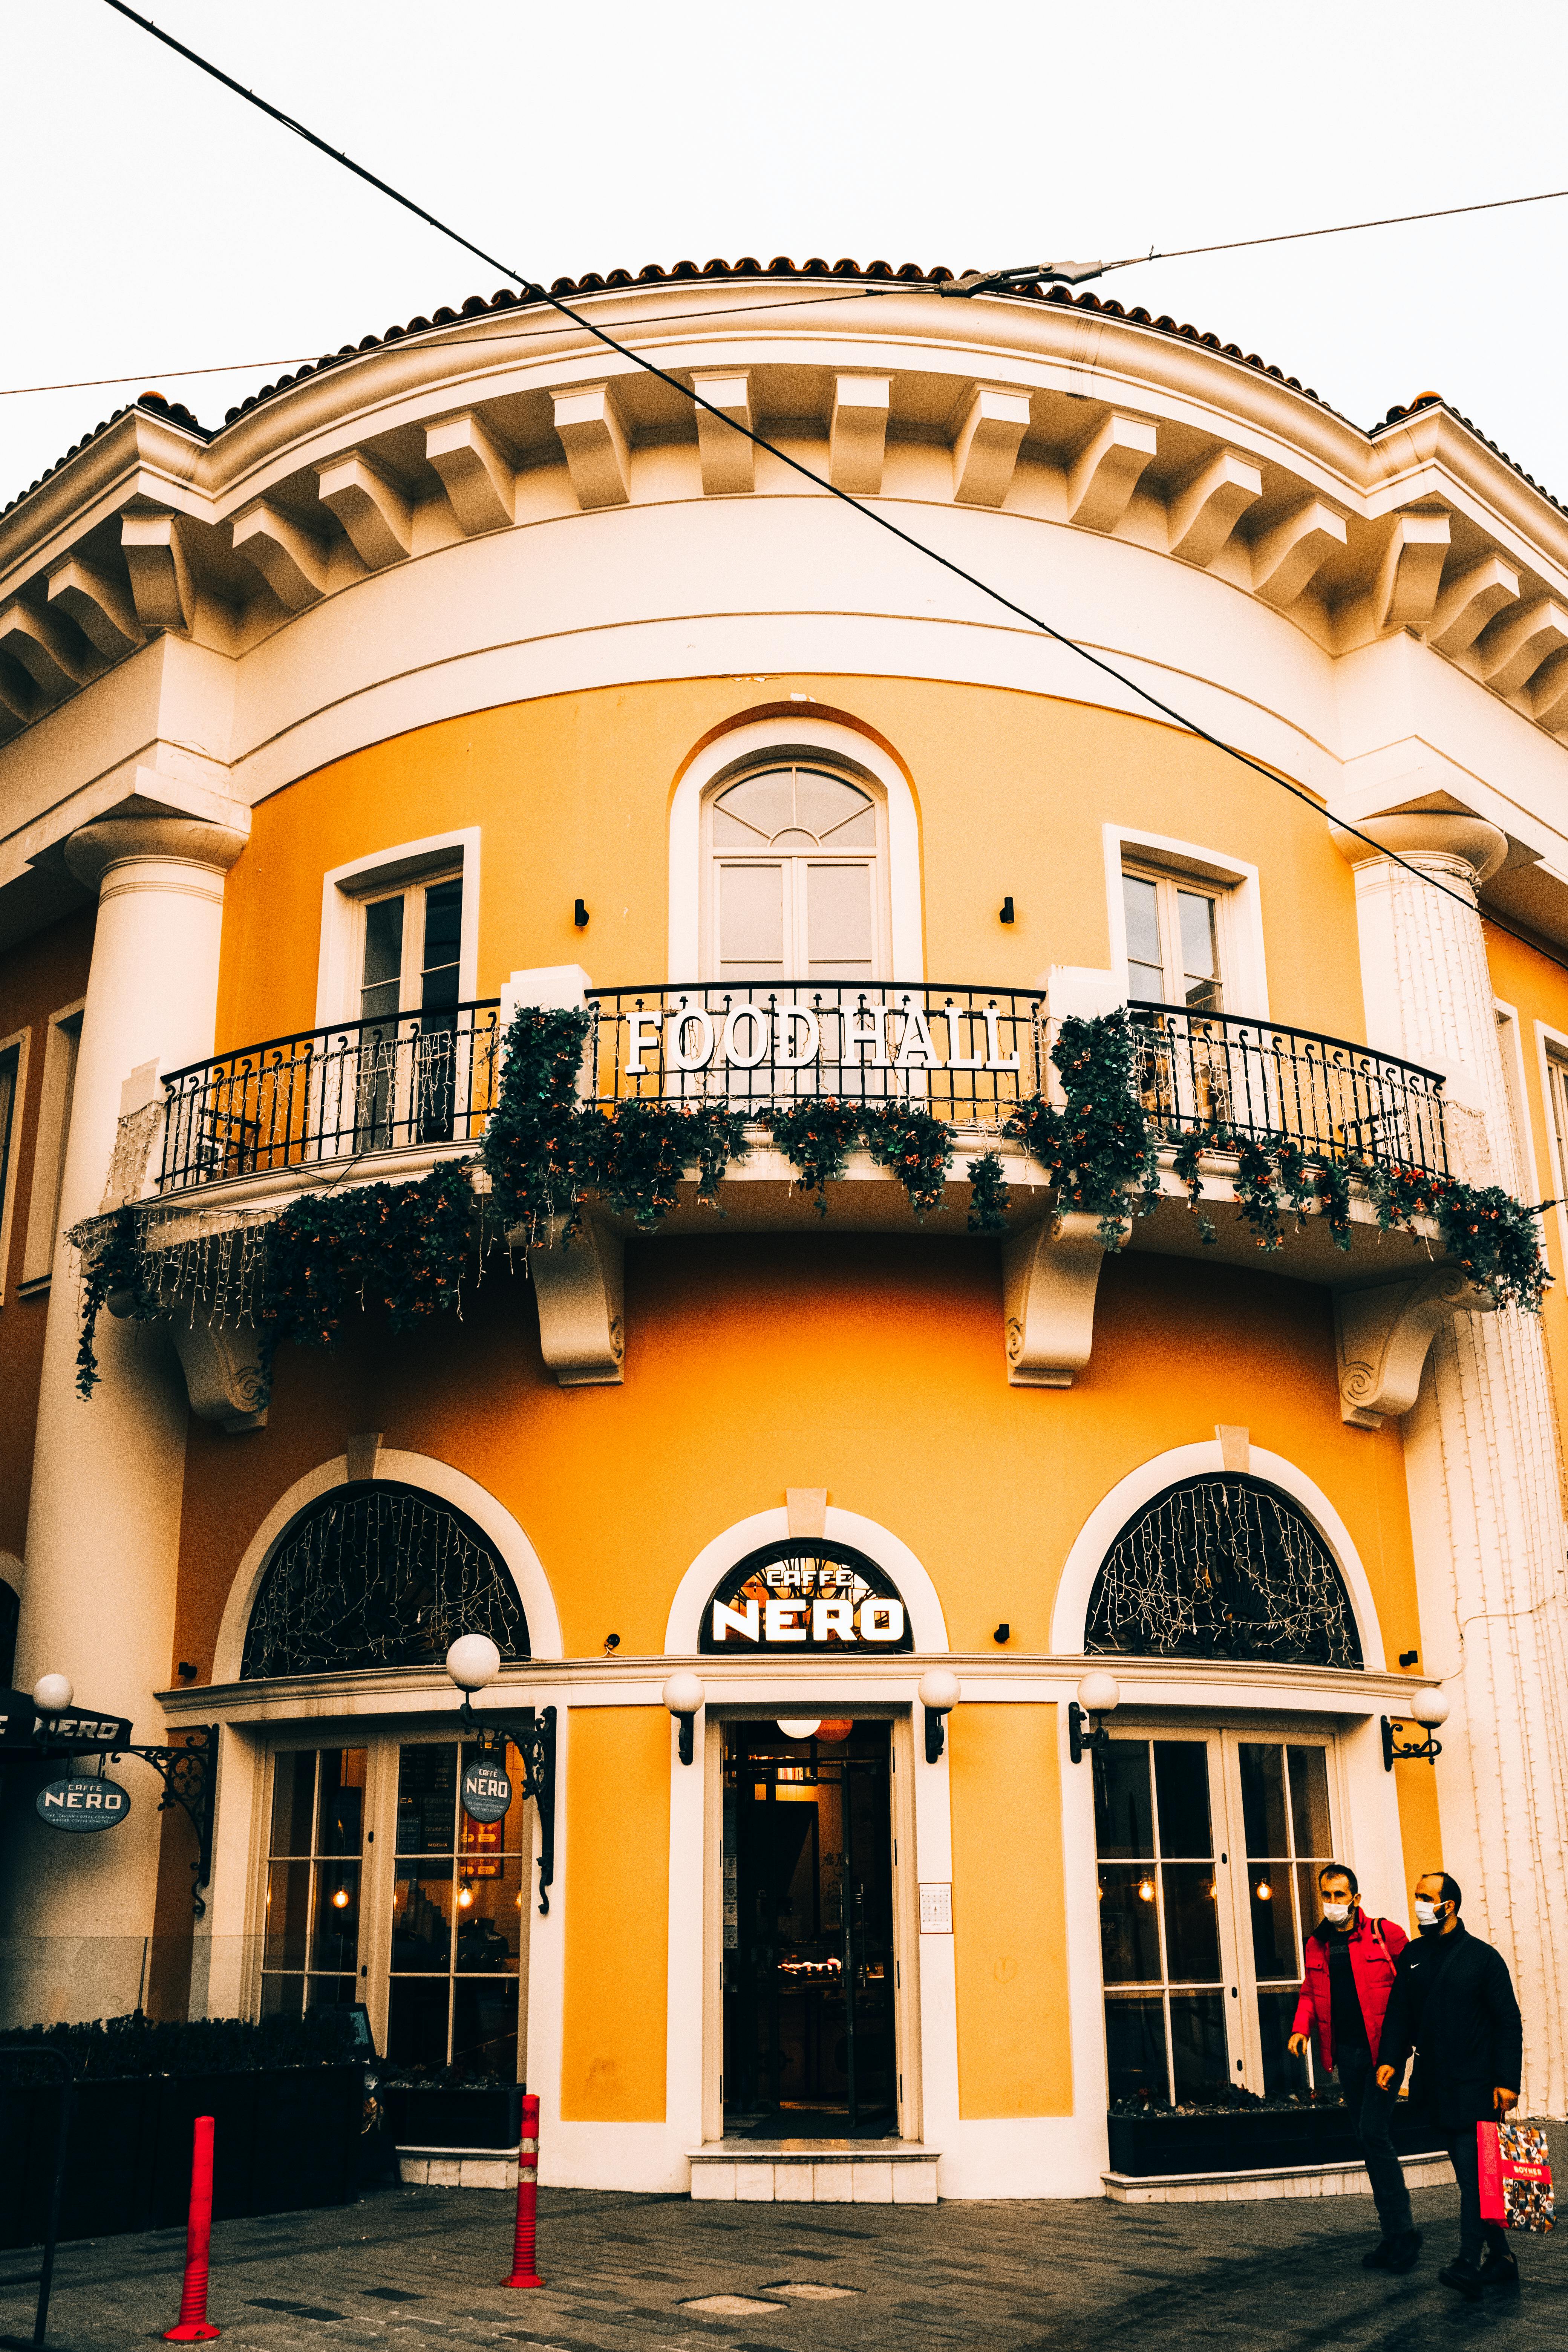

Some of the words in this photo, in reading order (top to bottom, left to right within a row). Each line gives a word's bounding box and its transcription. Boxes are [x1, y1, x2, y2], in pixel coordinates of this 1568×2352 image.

[625, 1004, 820, 1073] FOOD
[839, 1005, 1020, 1070] HALL
[713, 1599, 904, 1642] NERO
[466, 1777, 508, 1798] NERO
[45, 1792, 122, 1809] NERO
[1513, 2165, 1542, 2176] BOYNER
